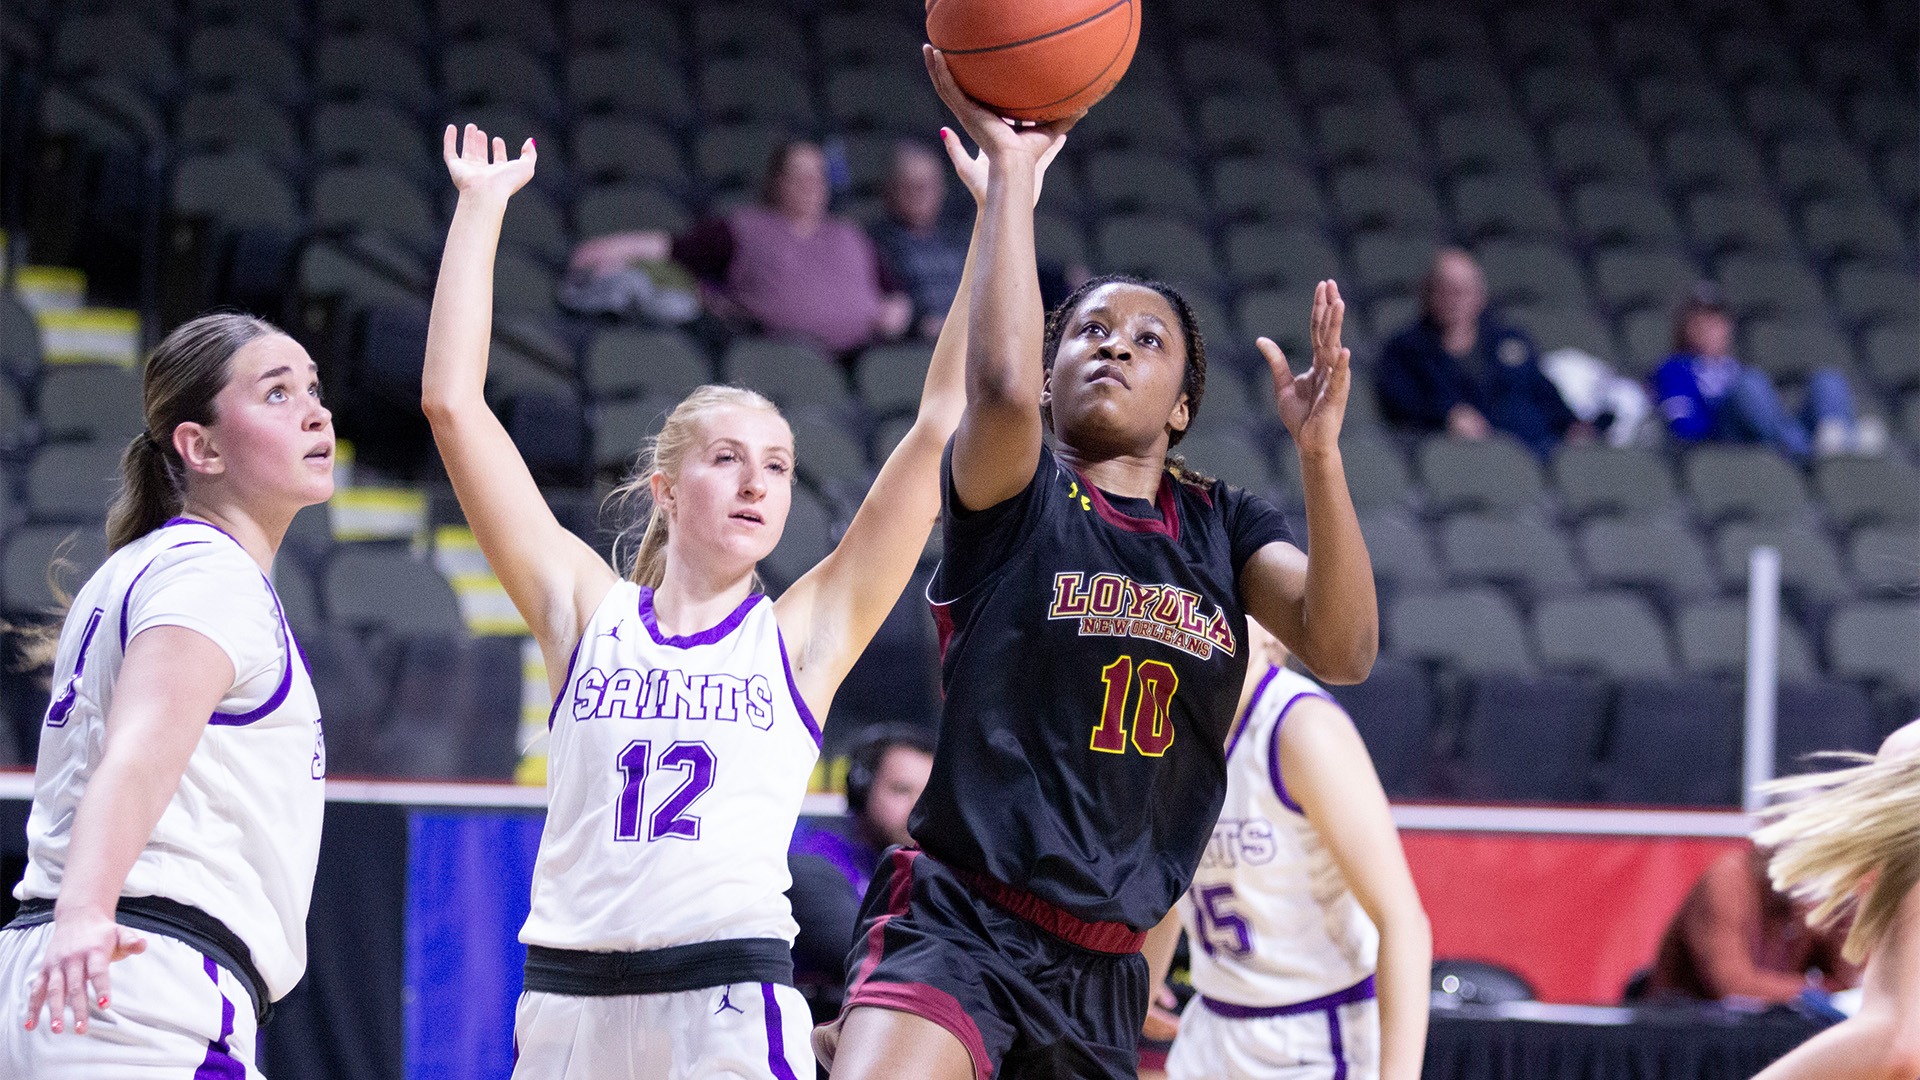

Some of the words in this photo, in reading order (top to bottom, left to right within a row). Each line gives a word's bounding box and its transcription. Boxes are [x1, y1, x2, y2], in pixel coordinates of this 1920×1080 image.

[1048, 571, 1236, 658] LOYOLA
[1078, 616, 1131, 637] NEW
[1129, 617, 1213, 661] ORLEANS
[573, 667, 774, 731] SAINTS
[1090, 655, 1179, 757] 10
[614, 739, 718, 842] 12
